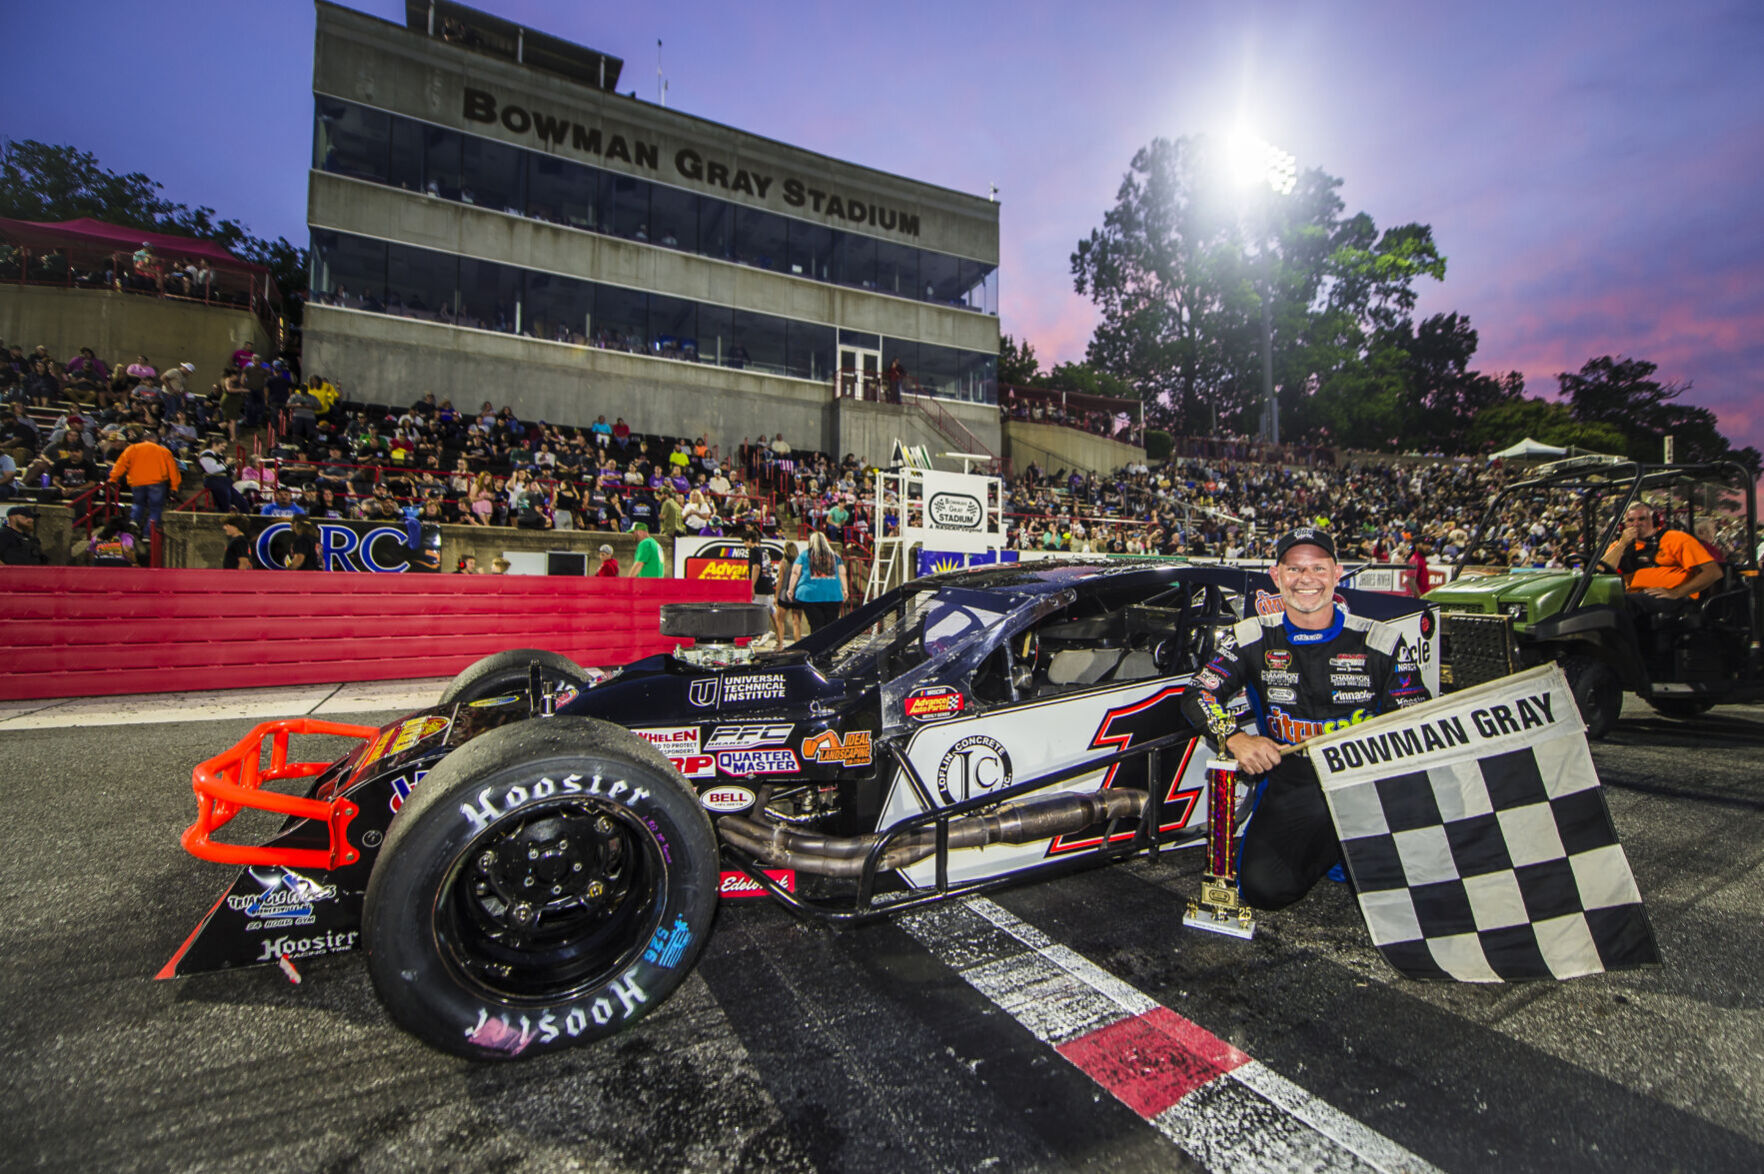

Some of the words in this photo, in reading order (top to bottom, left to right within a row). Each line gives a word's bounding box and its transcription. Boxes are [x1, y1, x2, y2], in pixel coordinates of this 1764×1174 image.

[462, 86, 659, 170] BOWMAN
[673, 147, 774, 200] GRAY
[782, 178, 921, 237] STADIUM
[939, 514, 974, 523] STADIUM
[732, 547, 749, 558] NAS
[724, 674, 786, 685] UNIVERSAL
[724, 683, 786, 694] TECHNICAL
[724, 690, 786, 702] INSTITUTE
[710, 724, 794, 742] PFC
[845, 732, 870, 745] IDEAL
[1321, 716, 1470, 773] BOWMAN
[1471, 693, 1556, 739] GRAY
[720, 751, 792, 767] QUARTER
[820, 746, 870, 760] LANDSCAPING
[669, 756, 713, 773] RP
[733, 760, 796, 773] MASTER
[938, 752, 954, 793] LOFLIN
[955, 736, 1006, 756] CONCRETE
[459, 773, 650, 835] Hoosier
[710, 793, 747, 803] BELL
[1239, 906, 1252, 920] 25
[256, 930, 358, 960] Hoosier
